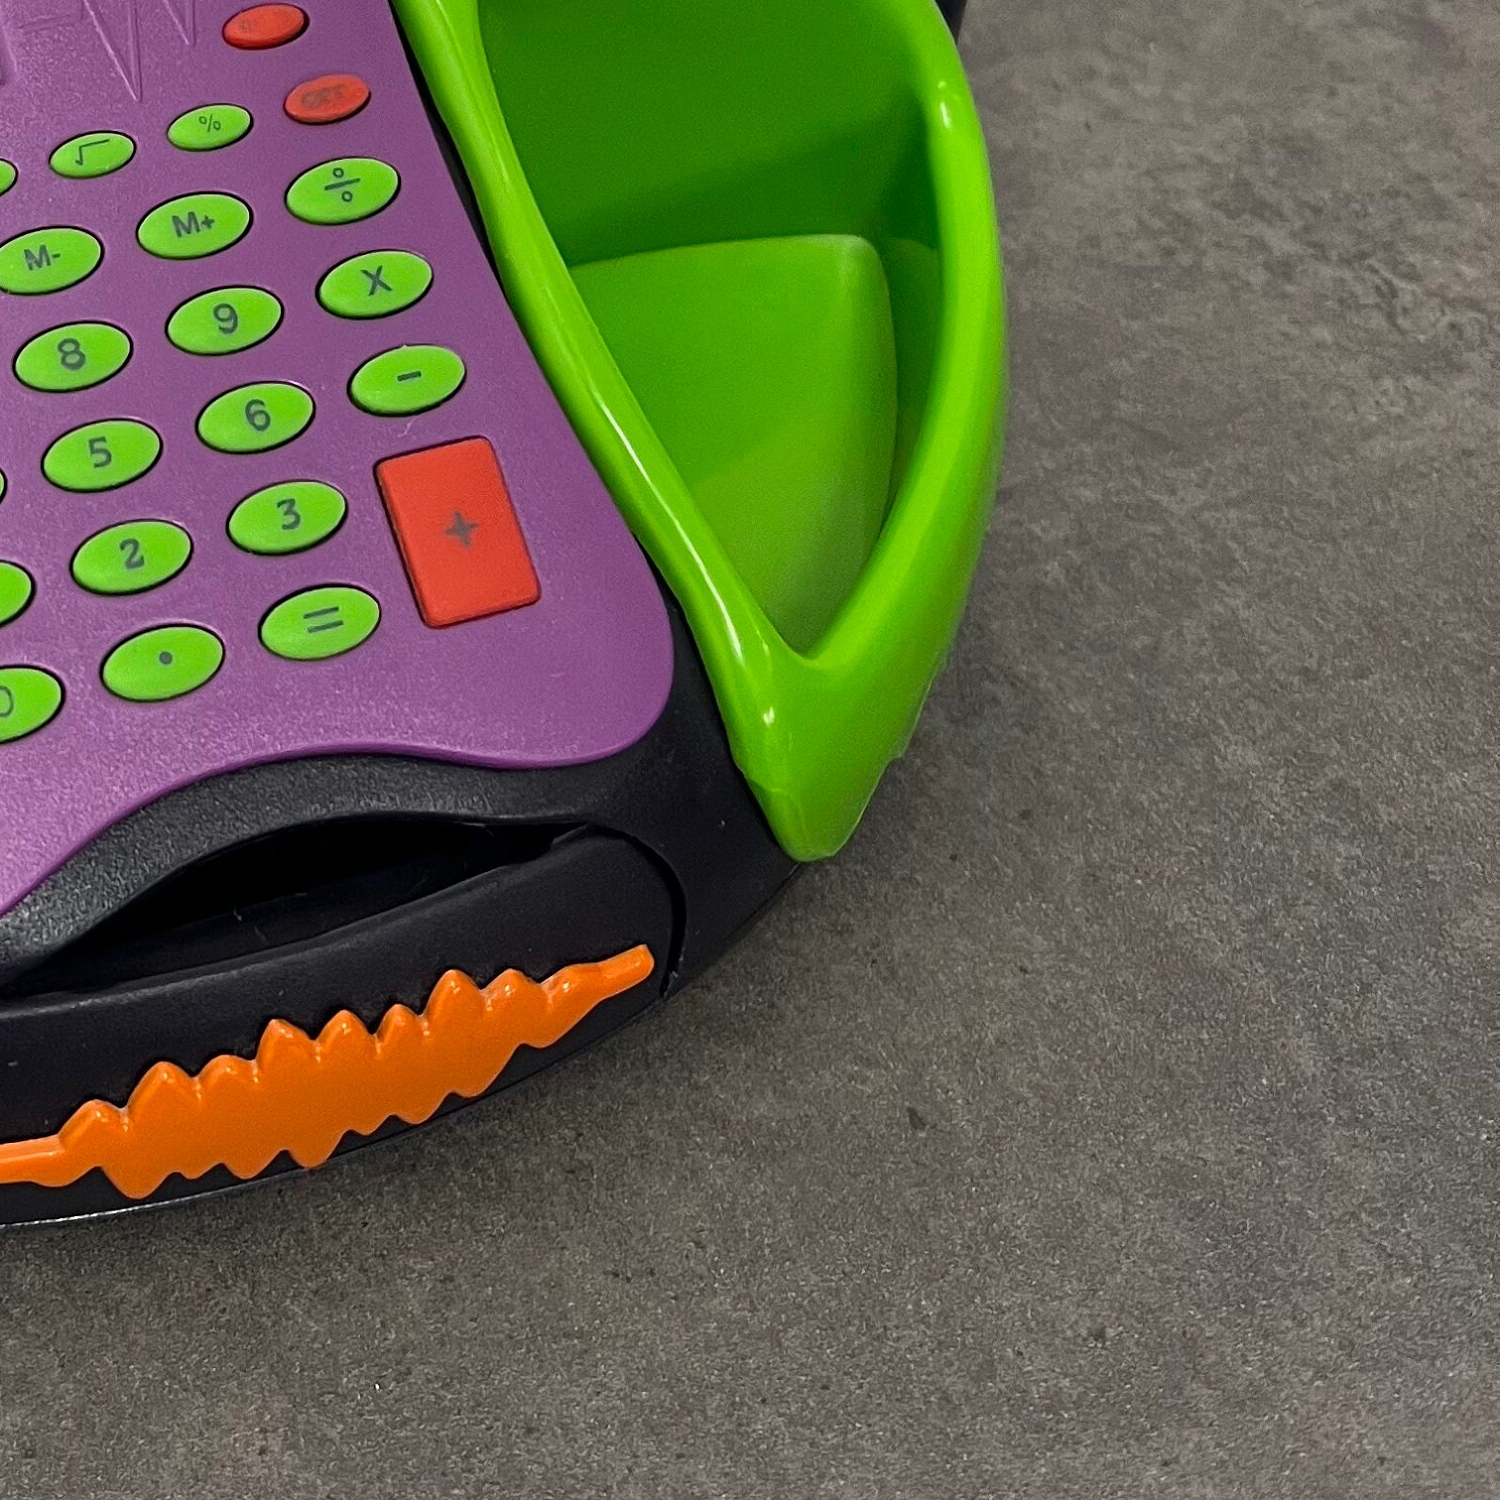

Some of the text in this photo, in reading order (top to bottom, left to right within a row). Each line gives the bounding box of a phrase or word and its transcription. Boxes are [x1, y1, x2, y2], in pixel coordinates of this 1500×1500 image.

[171, 210, 216, 239] M+
[23, 244, 62, 272] M-
[212, 302, 239, 336] 9
[56, 337, 87, 373] 8
[244, 398, 272, 433] 6
[87, 435, 113, 469] 5
[276, 497, 302, 531] 3
[118, 537, 146, 572] 2
